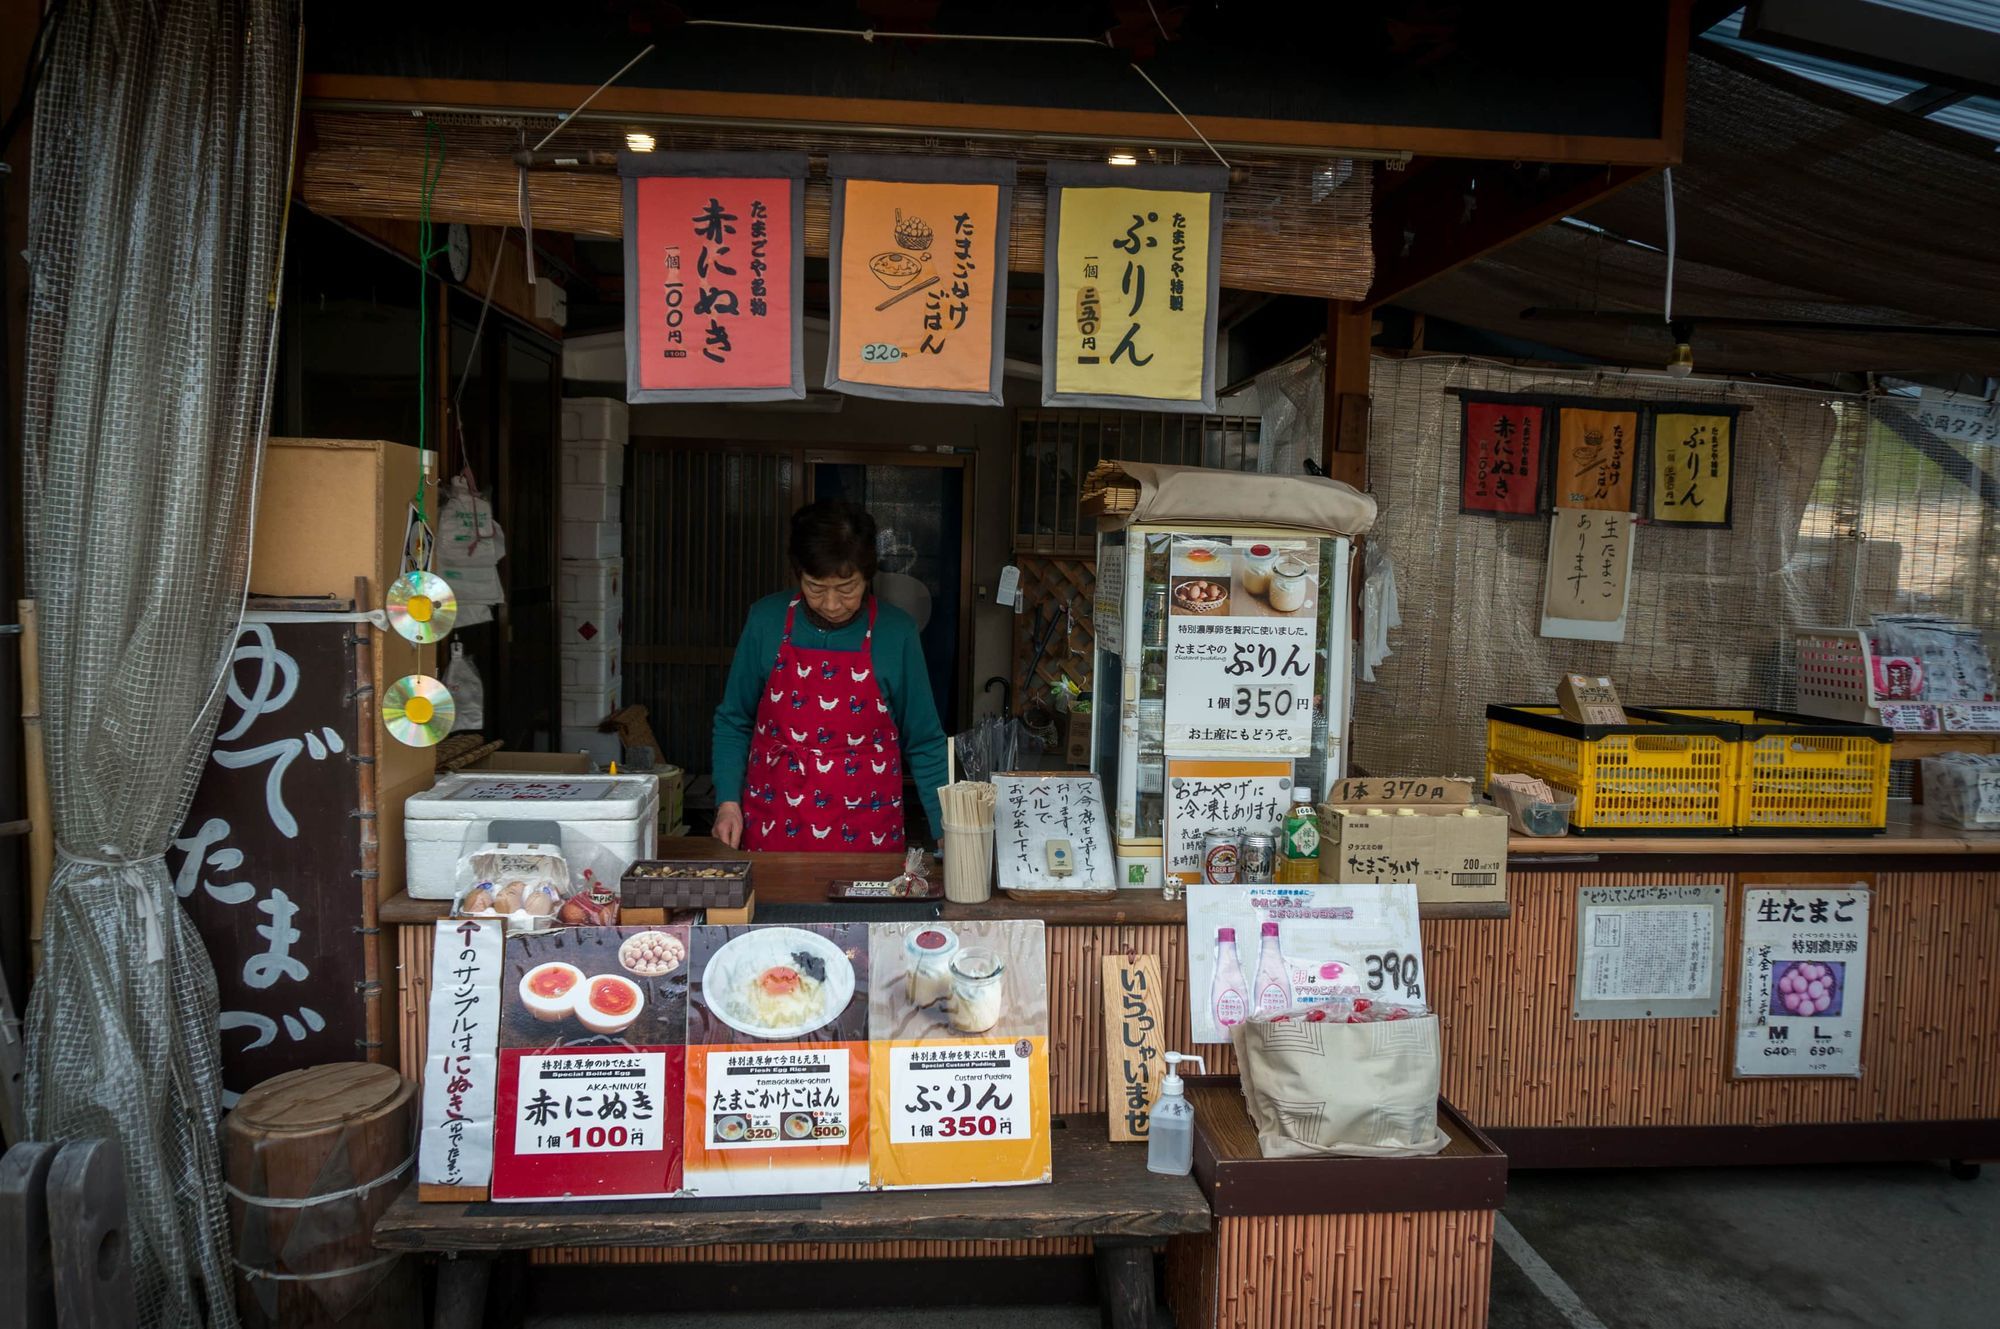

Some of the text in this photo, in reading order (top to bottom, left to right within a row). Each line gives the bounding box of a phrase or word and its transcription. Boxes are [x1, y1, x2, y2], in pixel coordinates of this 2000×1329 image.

[751, 201, 767, 317] たまごや名物
[950, 213, 975, 329] たまごかけ
[1169, 213, 1186, 312] たまごや特製
[692, 198, 739, 363] 赤にぬき
[1110, 212, 1158, 367] ぷりん
[920, 289, 949, 354] ごはん
[1491, 416, 1516, 499] 赤にぬき
[1680, 426, 1705, 507] ぷりん
[1601, 516, 1618, 598] 生たまご
[1175, 643, 1227, 655] たまごやの
[1225, 642, 1311, 678] ぷりん
[1188, 728, 1294, 741] お土産にもどうぞ。
[1175, 780, 1264, 800] おみやげに
[1343, 781, 1444, 800] 1本 370円
[1029, 786, 1052, 824] ベルで
[1176, 797, 1283, 822] 冷凍もあります。
[1073, 782, 1100, 881] 只今席をはずして
[1348, 855, 1420, 876] たまごかけ
[1591, 887, 1700, 903] どうしてこんなにおいしいの
[1757, 898, 1856, 923] 生たまご
[1792, 939, 1858, 954] 特別濃厚卵
[1365, 951, 1421, 998] 390円
[1768, 1026, 1832, 1039] M L
[542, 1058, 641, 1070] 特別濃厚卵のゆでたまご
[911, 1050, 1006, 1061] 特別濃厚卵を贅沢に使用
[1121, 968, 1157, 1136] いらっしゃいませ
[586, 1082, 647, 1092] AKA-NINUKI
[713, 1086, 840, 1111] たまごかけごはん
[905, 1083, 1013, 1113] ぷりん
[525, 1088, 653, 1126] 赤にぬき
[746, 1128, 777, 1138] 320円
[815, 1126, 844, 1136] 500円
